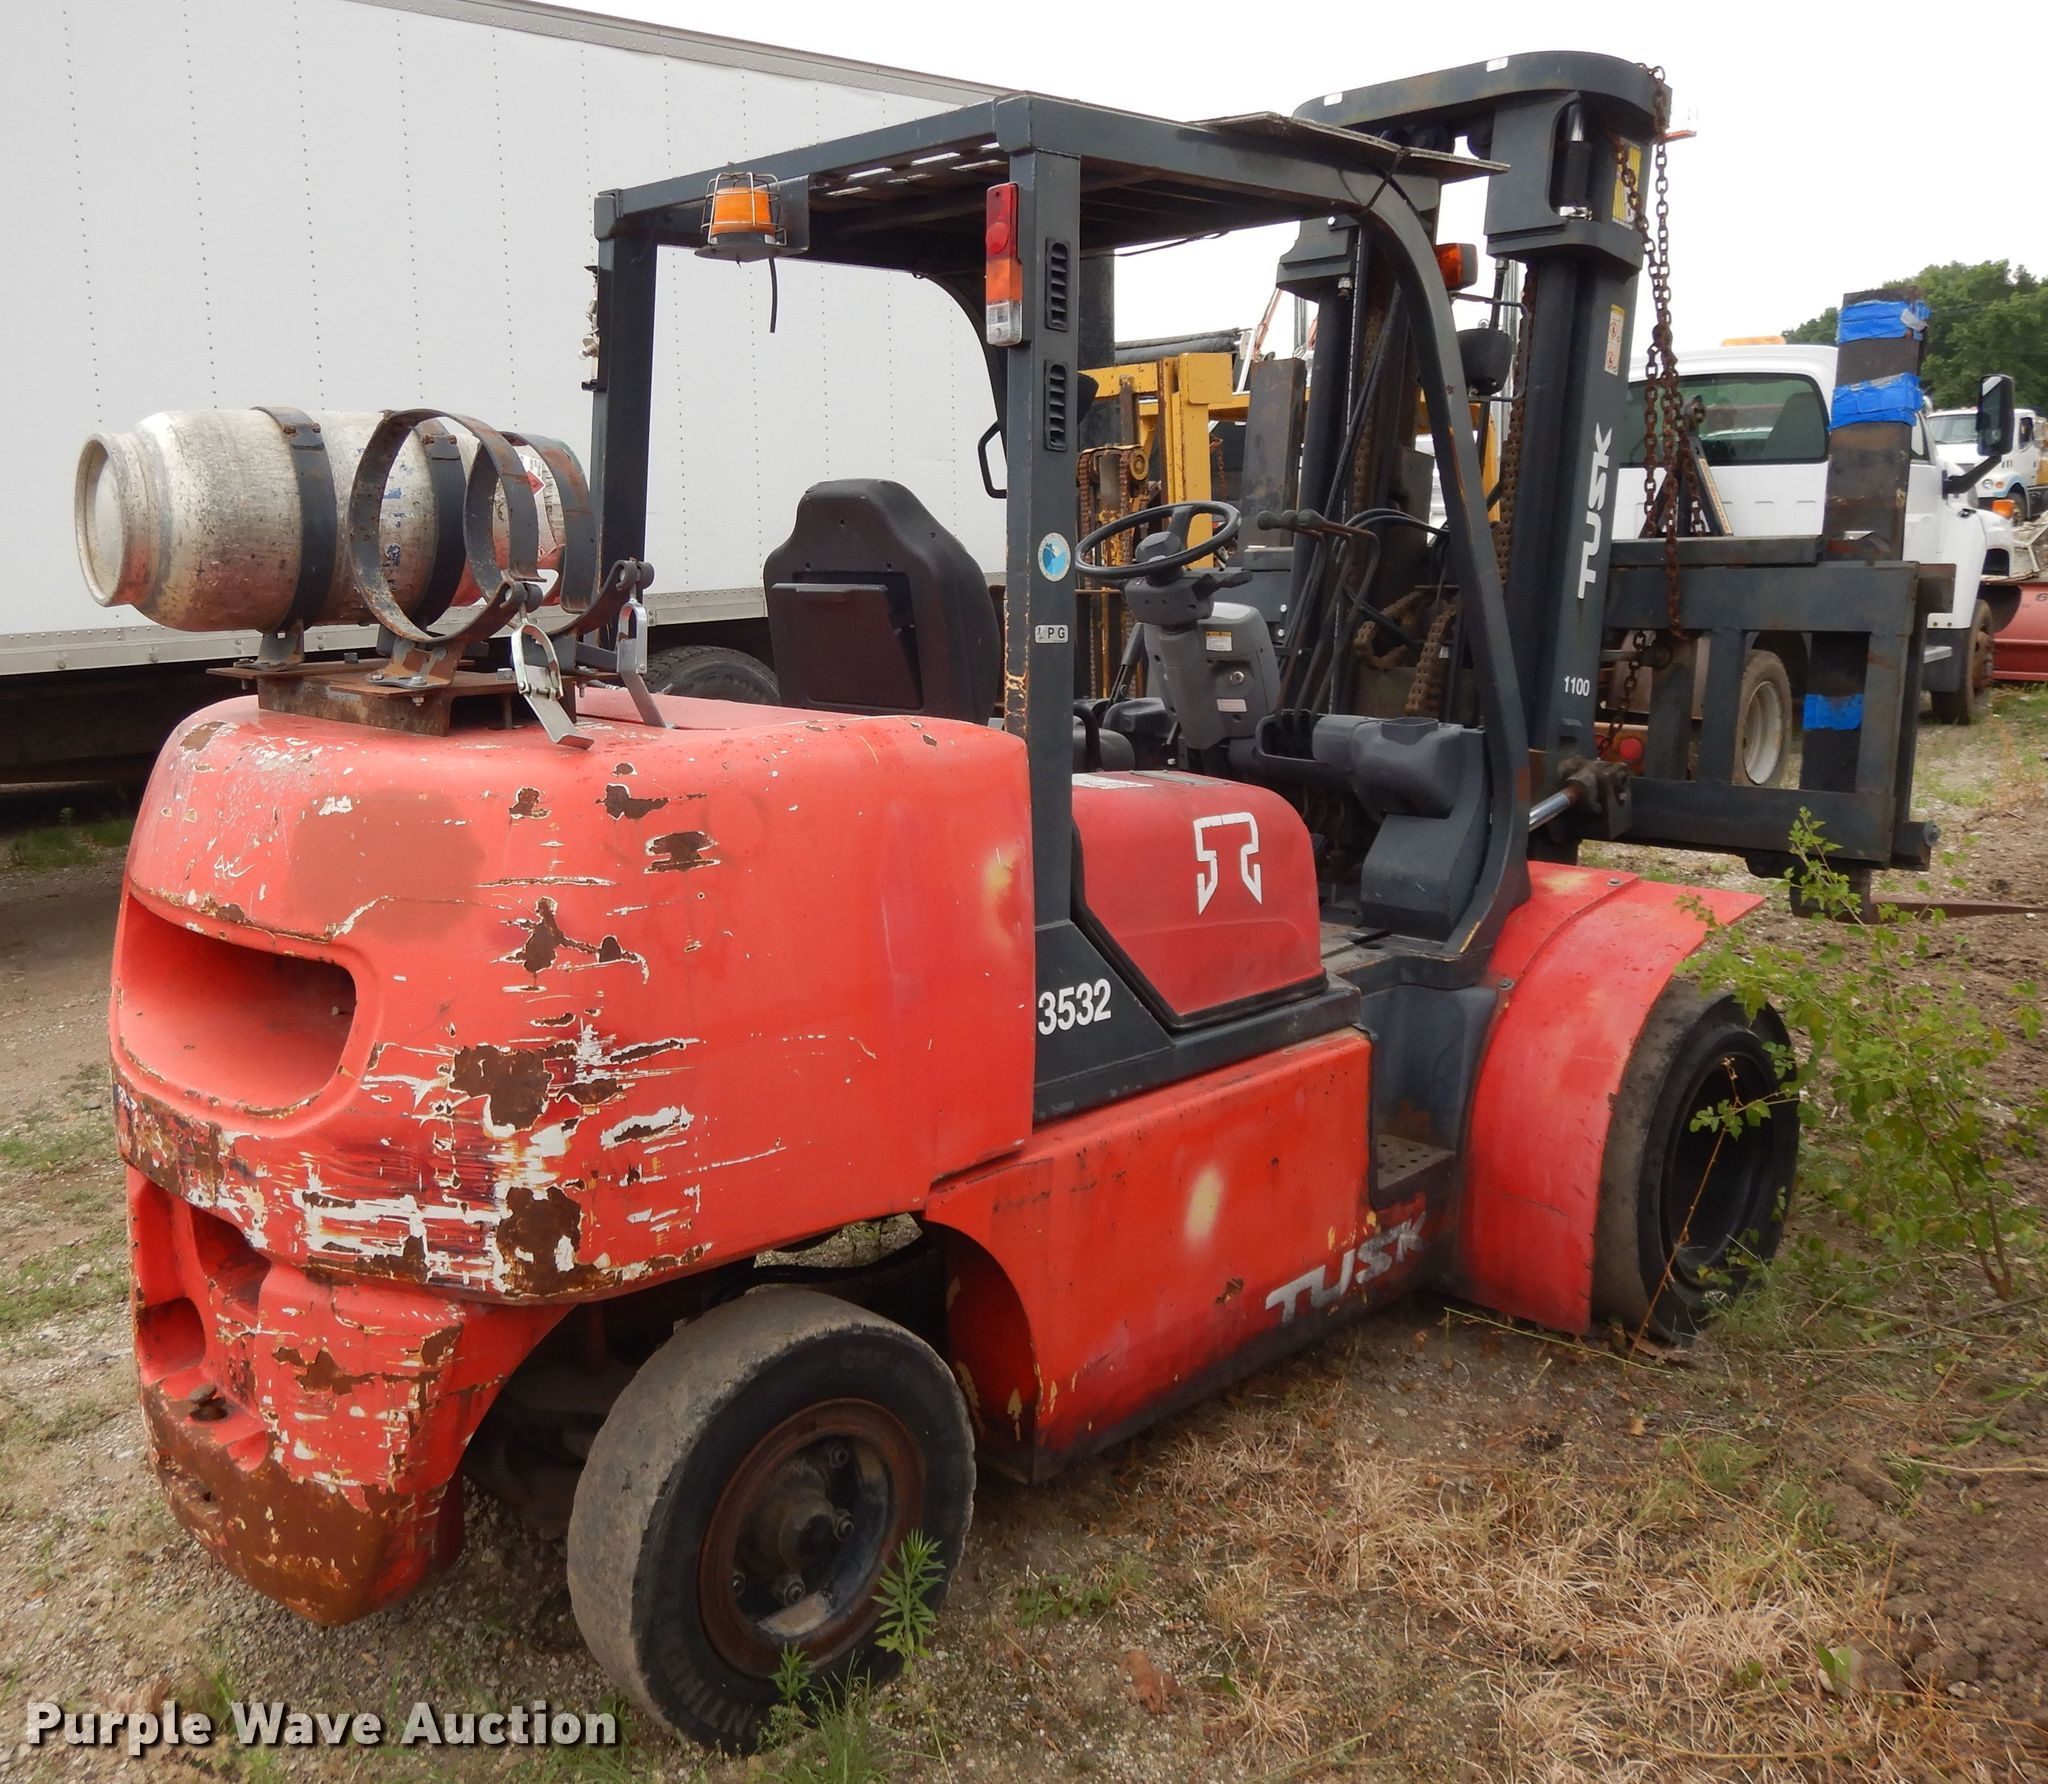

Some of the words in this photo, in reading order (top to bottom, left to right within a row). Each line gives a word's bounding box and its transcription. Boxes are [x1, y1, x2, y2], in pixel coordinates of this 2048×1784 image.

[1576, 421, 1613, 600] TUSK
[1564, 675, 1590, 697] 1100
[1037, 978, 1112, 1036] 3532
[1265, 1211, 1426, 1327] TUSK
